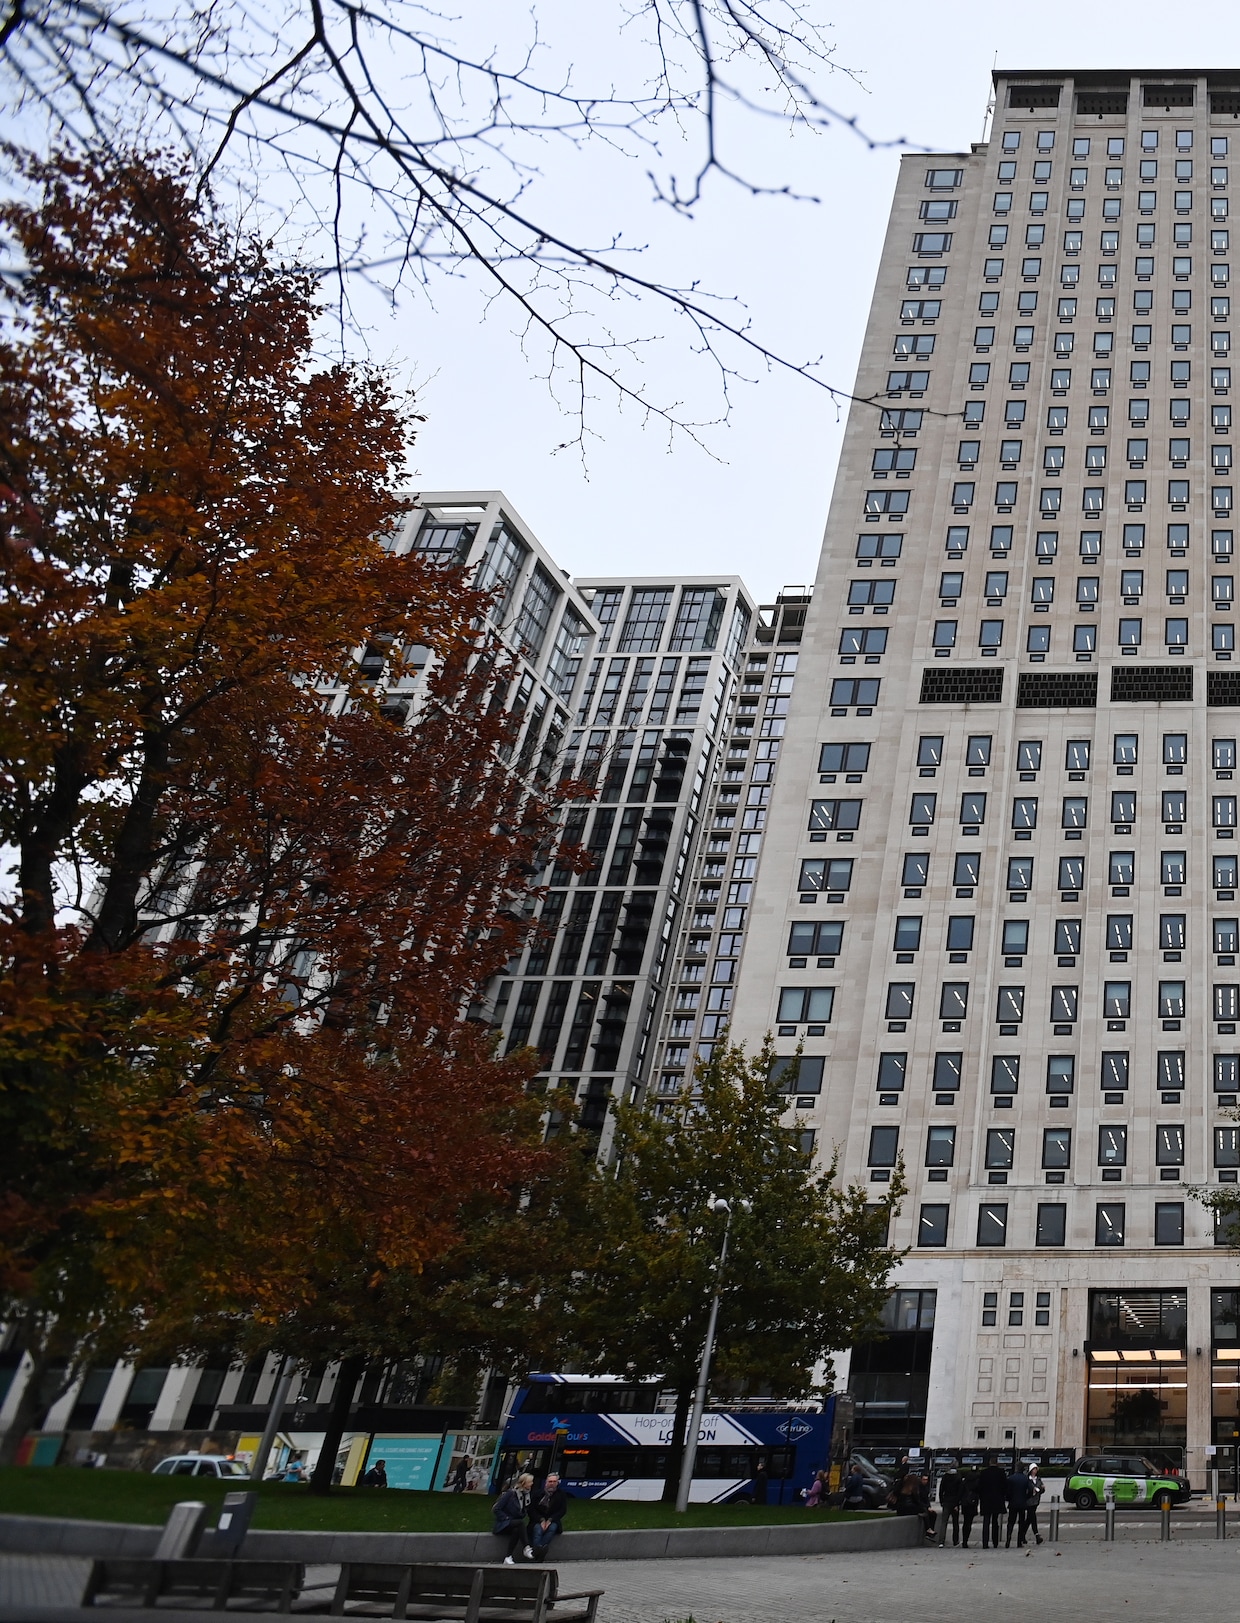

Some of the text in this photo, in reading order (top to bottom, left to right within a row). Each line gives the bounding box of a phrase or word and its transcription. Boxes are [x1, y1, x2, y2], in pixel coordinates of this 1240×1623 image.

[527, 1431, 589, 1442] Golde ours
[658, 1430, 716, 1441] LOON
